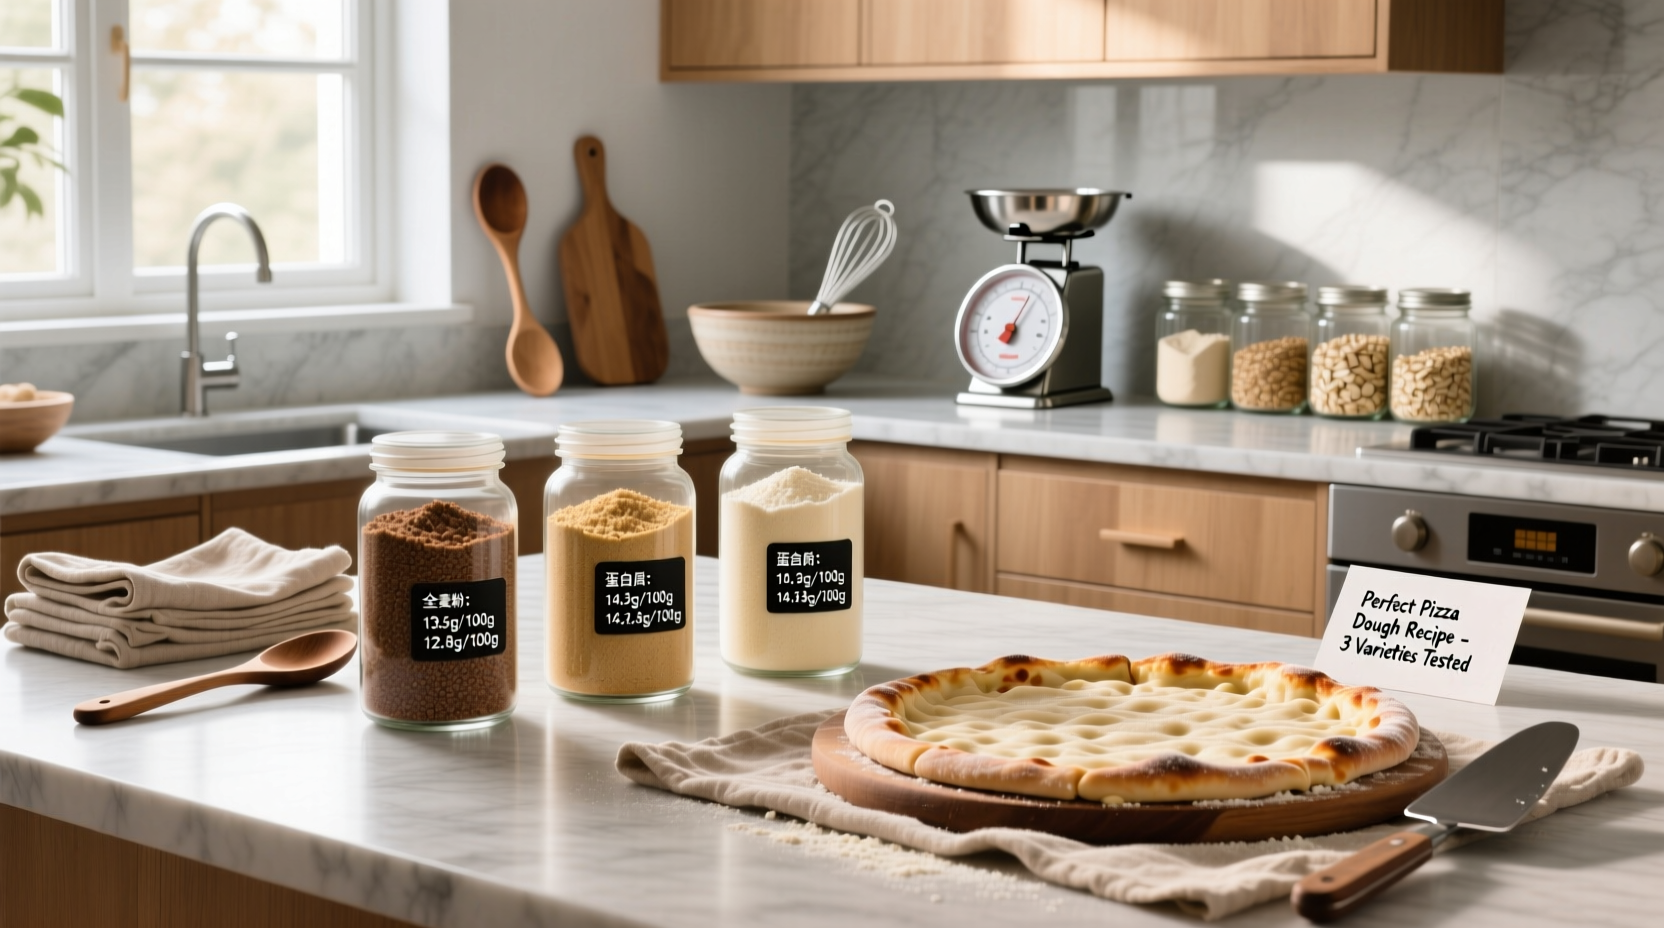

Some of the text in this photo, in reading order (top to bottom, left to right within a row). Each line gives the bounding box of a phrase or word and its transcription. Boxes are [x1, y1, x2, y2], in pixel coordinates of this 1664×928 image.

[605, 590, 674, 609] 14.3g/100g
[1361, 590, 1460, 621] Perfect Pizza
[423, 612, 495, 633] 13.5g/100g
[1352, 612, 1400, 638] Dough
[1405, 621, 1455, 648] Recipe
[424, 631, 499, 653] 12.8g/100g
[1339, 635, 1472, 672] 3 Varieties Tested
